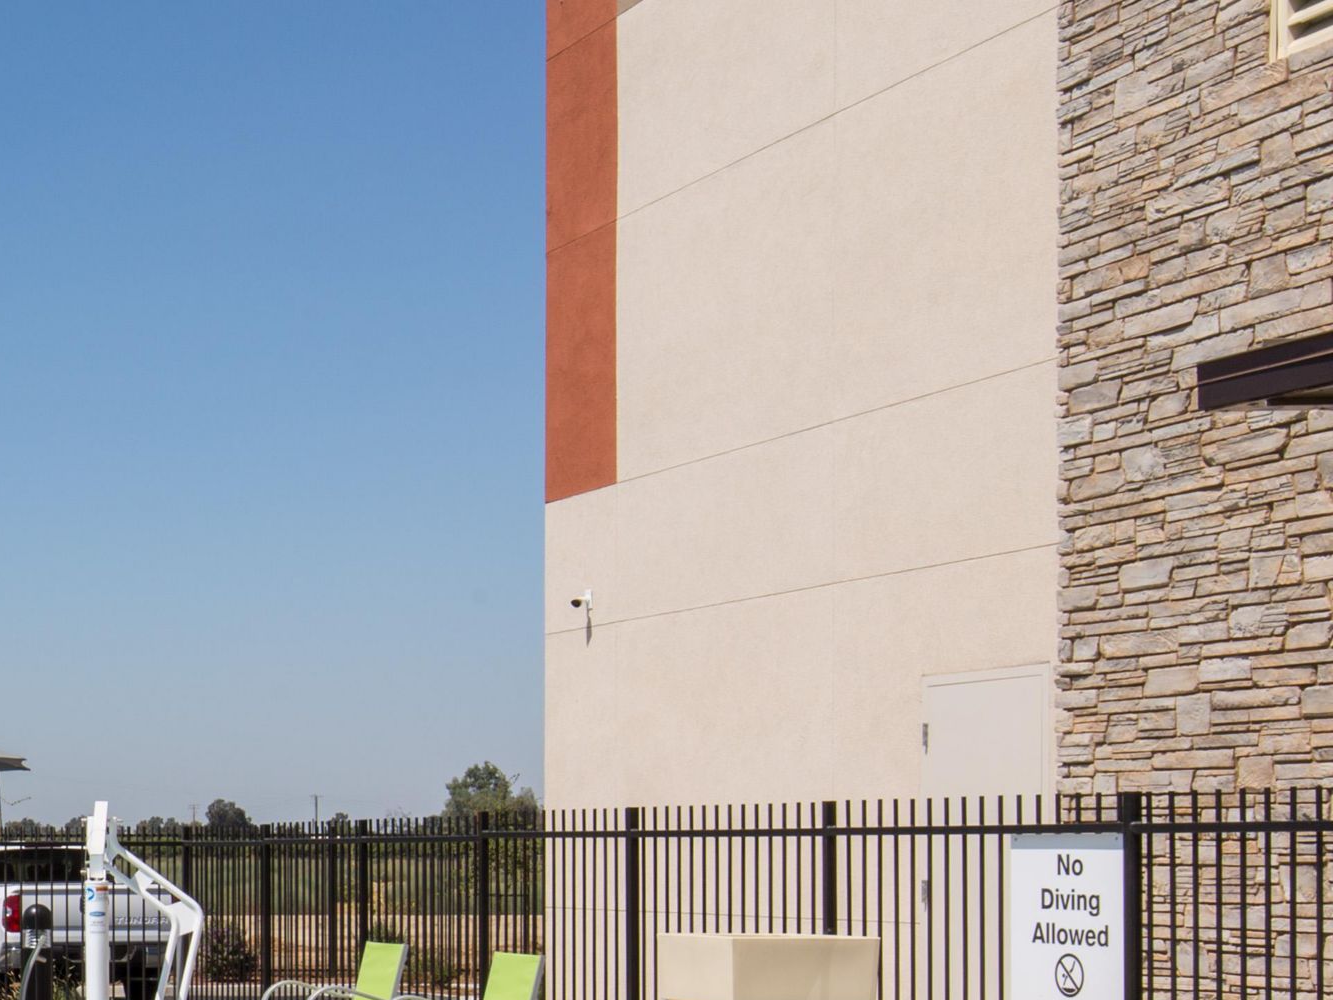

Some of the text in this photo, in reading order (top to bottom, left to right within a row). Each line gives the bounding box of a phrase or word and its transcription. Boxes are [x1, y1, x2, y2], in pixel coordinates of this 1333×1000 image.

[1057, 854, 1083, 876] No
[1041, 888, 1100, 917] Diving
[1032, 922, 1109, 947] Allowed
